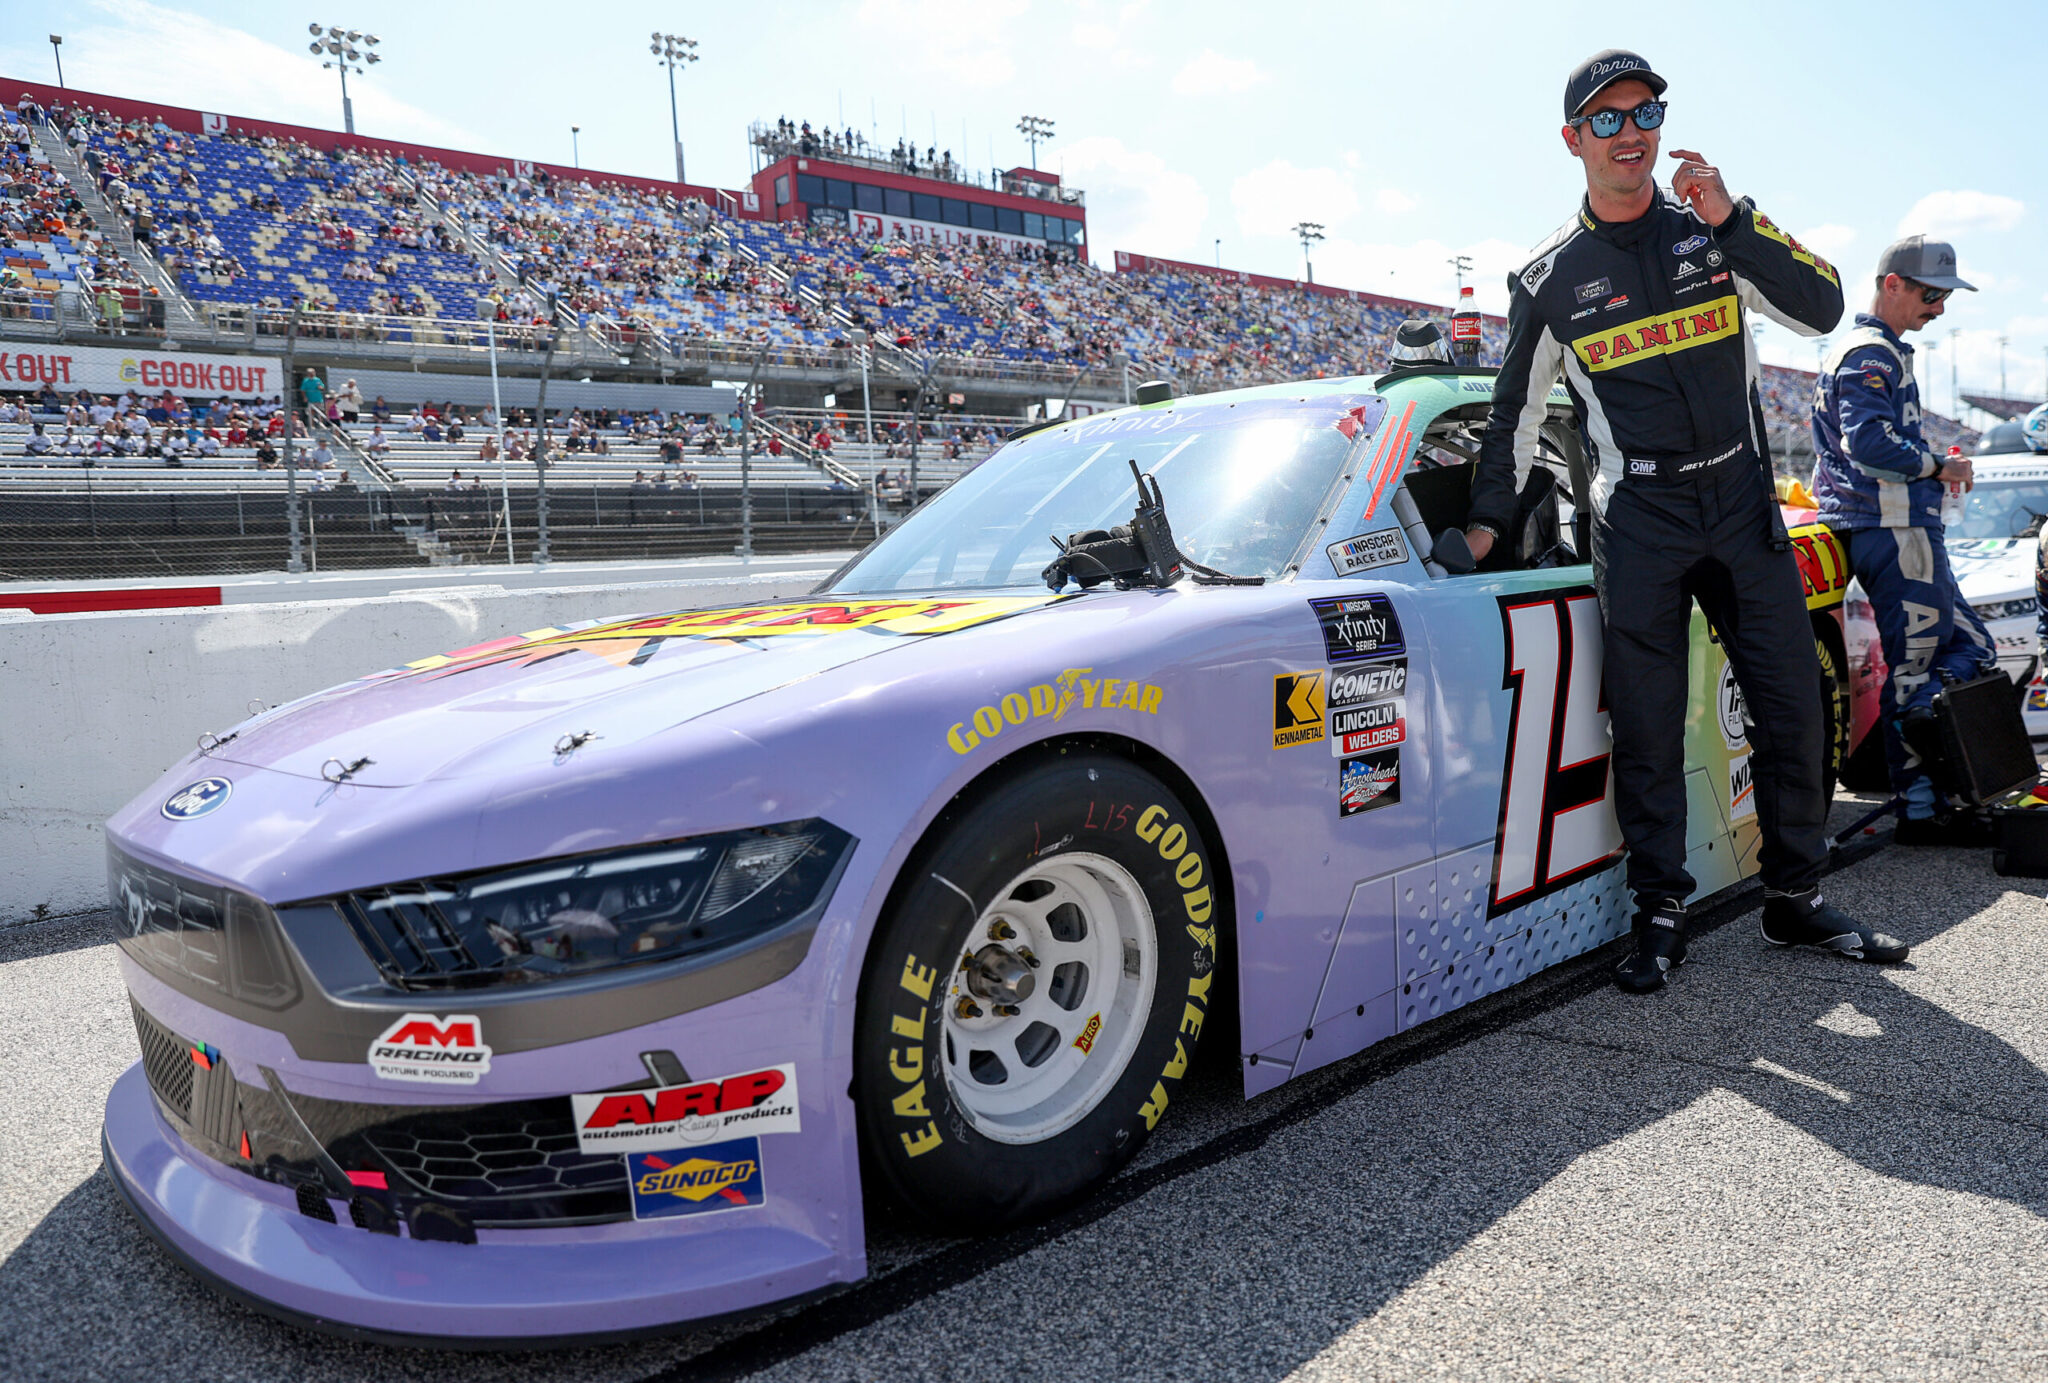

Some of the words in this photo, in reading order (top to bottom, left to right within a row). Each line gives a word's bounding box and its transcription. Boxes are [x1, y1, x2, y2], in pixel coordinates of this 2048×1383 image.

[1590, 57, 1640, 81] Panini
[211, 116, 221, 131] J
[518, 163, 530, 177] K
[1679, 237, 1701, 253] Ford
[1526, 262, 1548, 285] OMP
[1581, 285, 1605, 298] xfinity
[1570, 306, 1597, 321] AIRBOX
[1584, 305, 1729, 364] PANINI
[16, 353, 73, 384] OUT
[140, 359, 215, 391] COOK
[219, 365, 267, 393] OUT
[1860, 359, 1893, 373] FORD
[1462, 381, 1495, 393] JOE
[1630, 461, 1657, 474] OMP
[1679, 461, 1706, 473] JOEY
[1707, 447, 1737, 467] LOGANO
[1353, 534, 1396, 554] NASCAR
[1345, 552, 1377, 568] RACE
[1378, 547, 1400, 561] CAR
[1344, 600, 1372, 612] NASCAR
[1335, 614, 1386, 646] xfinity
[1355, 639, 1377, 652] SERIES
[1331, 665, 1406, 700] COMETIC
[1335, 696, 1365, 705] GASKET
[1335, 706, 1393, 733] LINCOLN
[1274, 726, 1324, 747] KENNAMETAL
[1348, 727, 1400, 750] WELDERS
[1340, 760, 1399, 791] Arrowhead
[168, 780, 221, 815] Ford
[1353, 784, 1380, 801] Brass
[1084, 801, 1134, 831] L15
[1651, 916, 1675, 928] PUMA
[385, 1021, 475, 1048] AM
[1080, 1019, 1099, 1049] AERO
[375, 1047, 485, 1062] RACING
[889, 953, 943, 1158] EAGLE
[380, 1065, 420, 1076] FUTURE
[423, 1069, 474, 1079] FOCUSED
[583, 1069, 786, 1129] ARP
[582, 1123, 676, 1140] automotive
[678, 1114, 720, 1137] Racing
[723, 1105, 794, 1126] products
[643, 1162, 751, 1192] SUNOCO
